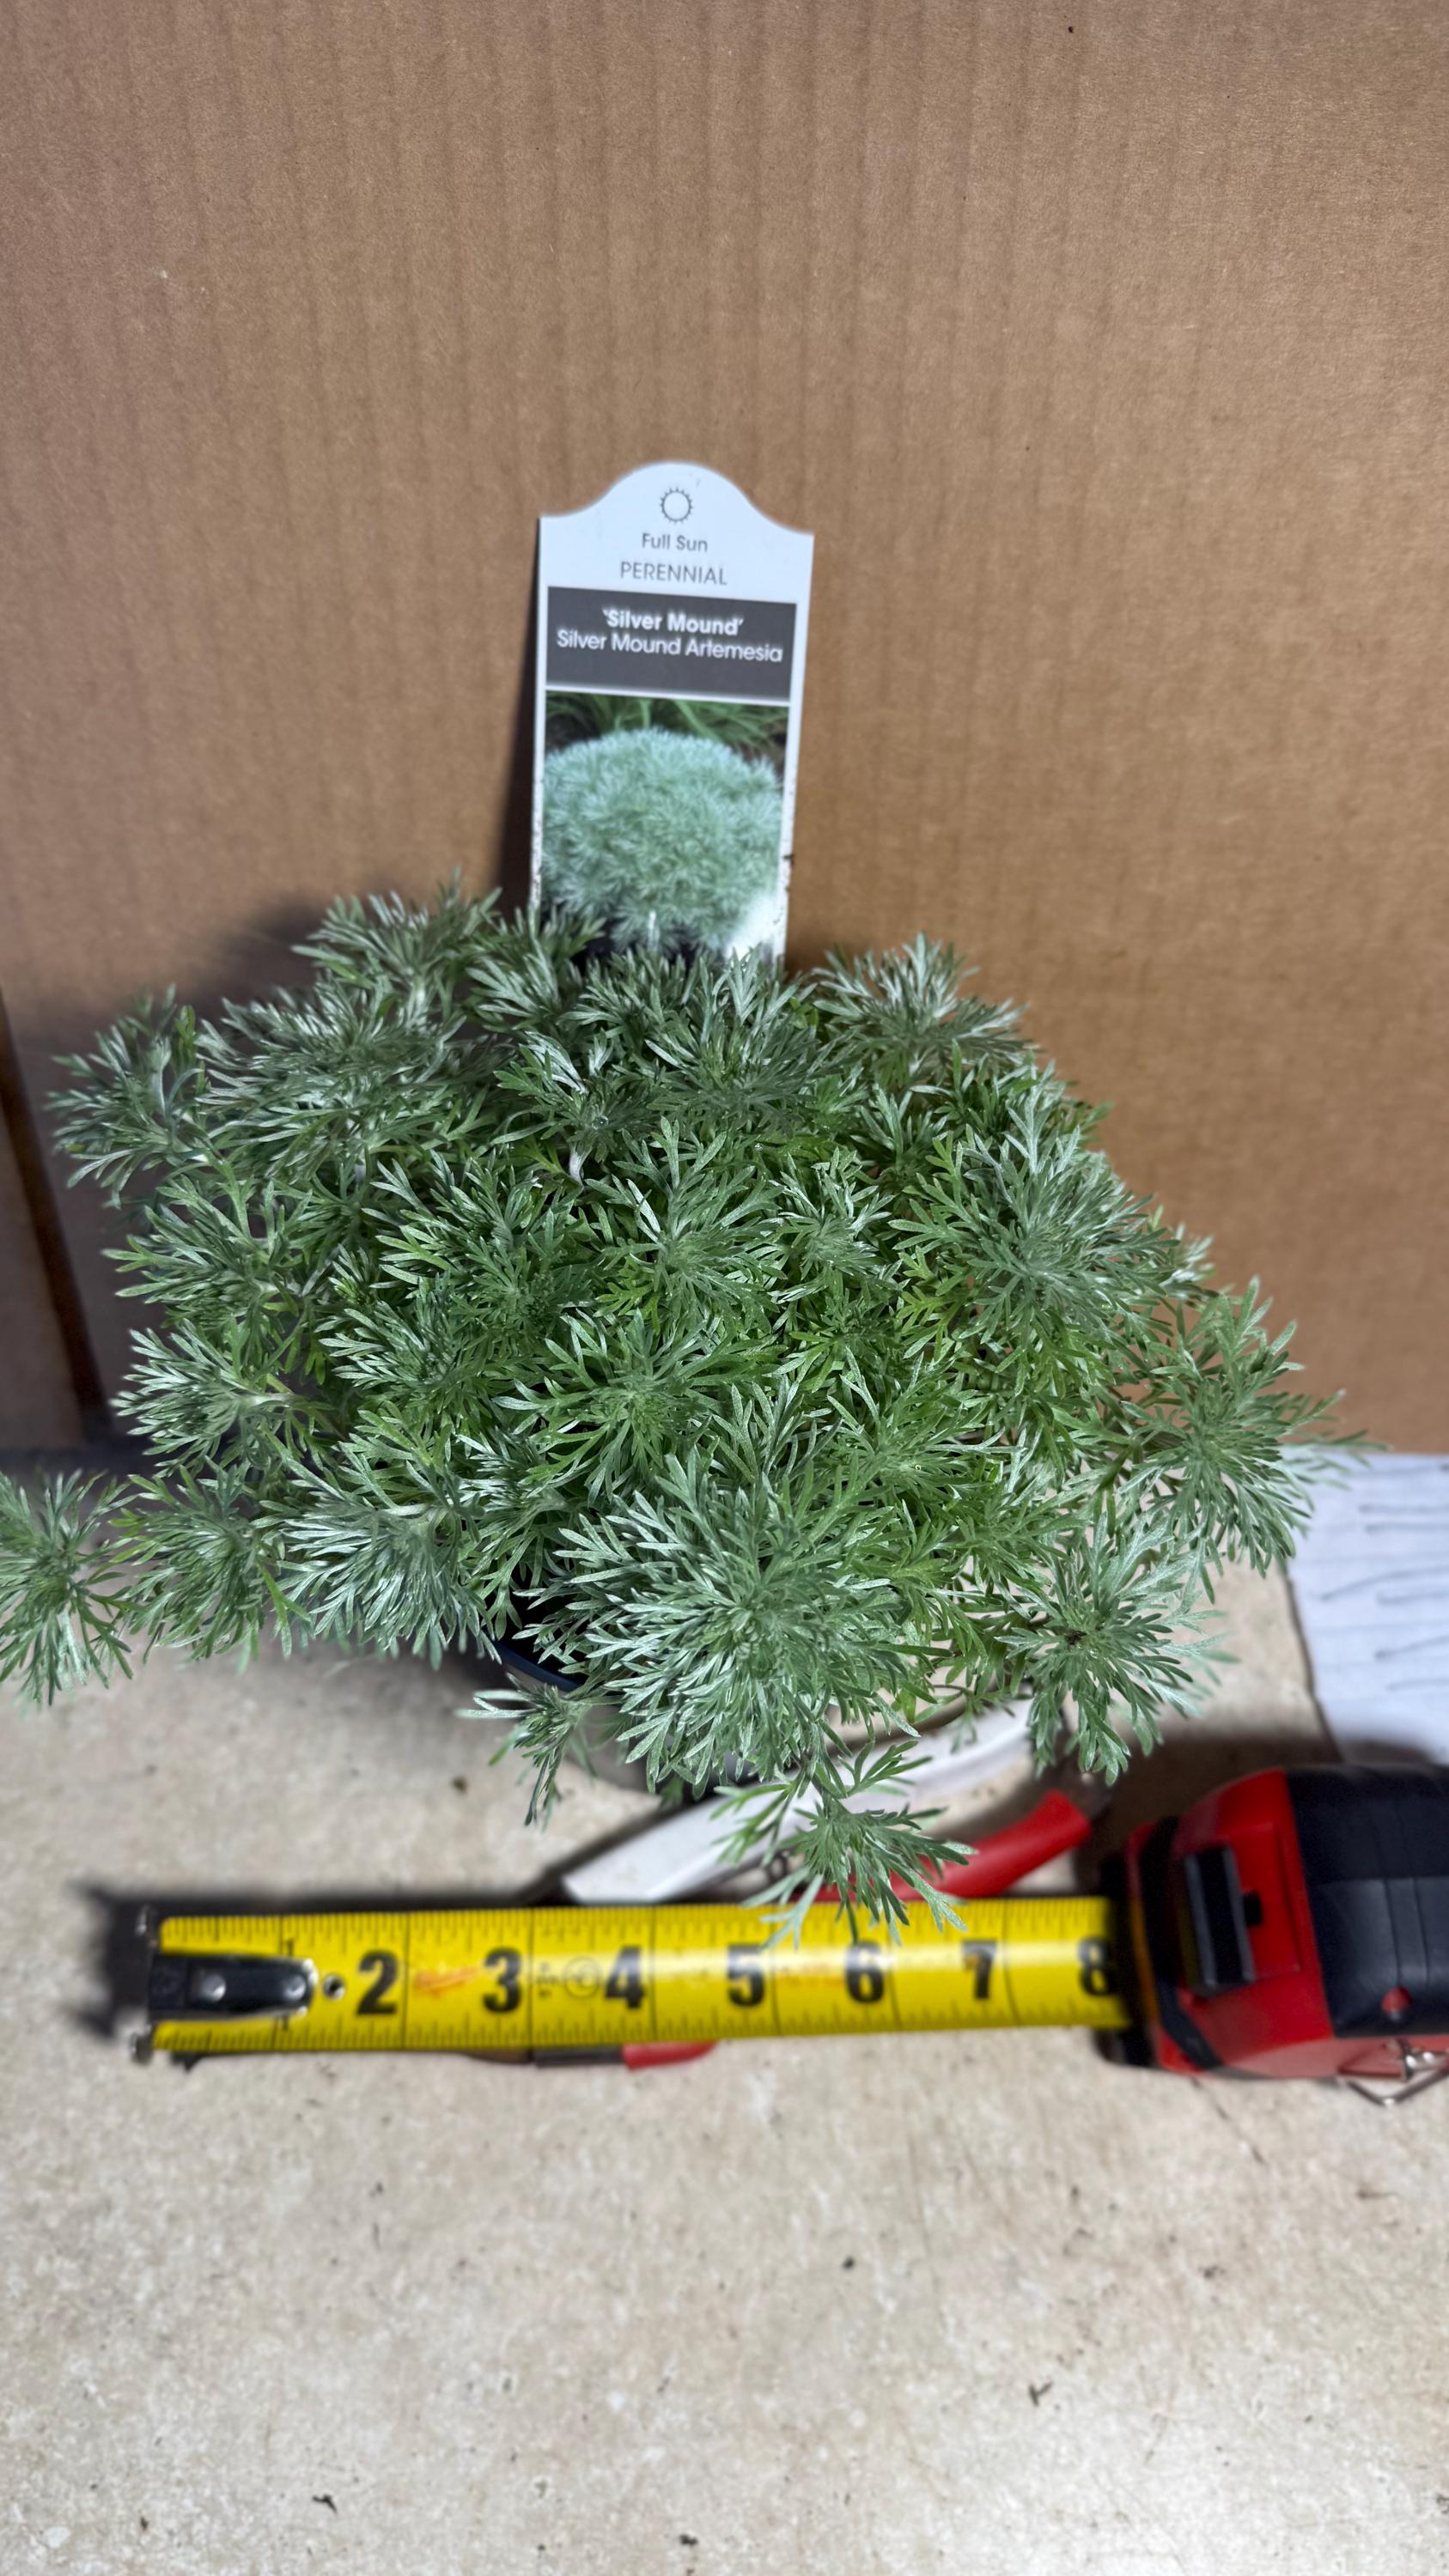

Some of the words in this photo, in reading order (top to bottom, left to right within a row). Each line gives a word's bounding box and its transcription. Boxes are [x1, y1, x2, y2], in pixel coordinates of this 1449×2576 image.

[642, 532, 671, 550] Full
[676, 534, 708, 552] Sun
[619, 561, 728, 586] PERENNIAL
[667, 611, 744, 636] Mound'
[557, 629, 607, 650] Silver
[611, 633, 681, 656] Mound
[685, 638, 783, 663] Artemesia
[355, 1948, 399, 2017] 2
[482, 1946, 523, 2014] 3
[605, 1944, 645, 2011] 4
[726, 1943, 766, 2008] 5
[845, 1939, 885, 2004] 6
[961, 1938, 998, 2000] 7
[1076, 1935, 1112, 1997] 8
